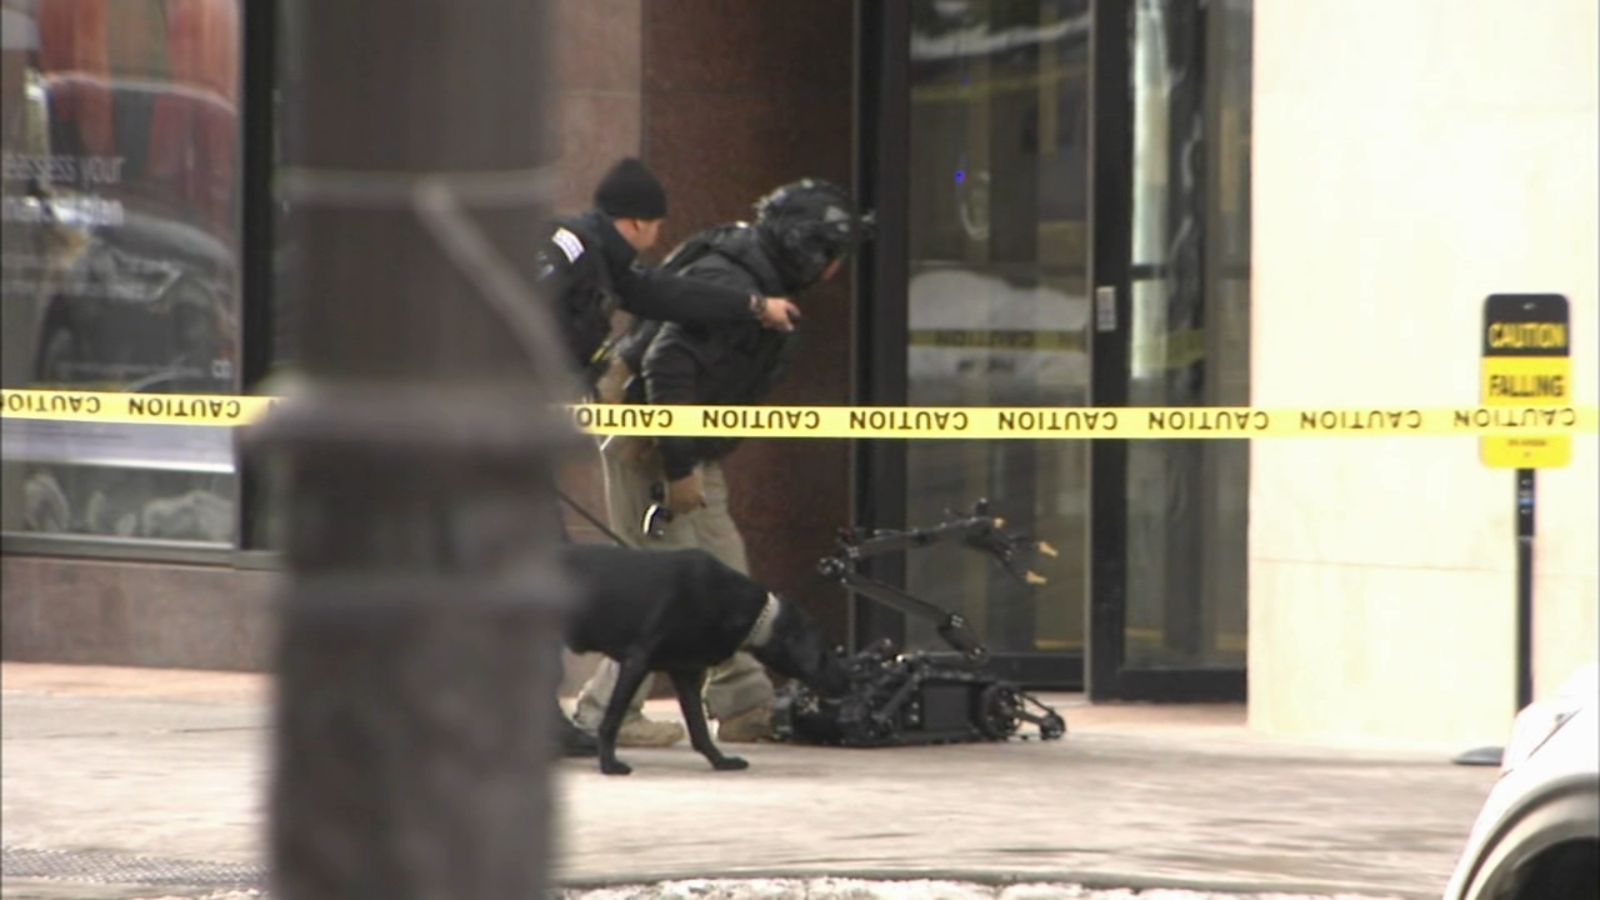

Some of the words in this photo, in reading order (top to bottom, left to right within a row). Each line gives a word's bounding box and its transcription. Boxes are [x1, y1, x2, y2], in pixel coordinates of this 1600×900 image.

[1488, 322, 1566, 348] CAUTION
[1489, 374, 1564, 397] FALLING
[0, 393, 101, 413] CAUTIO
[129, 397, 240, 418] CAUTION
[574, 407, 674, 428] CAUTIO
[702, 409, 820, 429] CAUTION
[849, 410, 968, 430] CAUTION
[998, 411, 1118, 431] CAUTION
[1148, 411, 1269, 430] CAUTION
[1300, 409, 1422, 429] CAUTION
[1453, 408, 1576, 427] CAUTION
